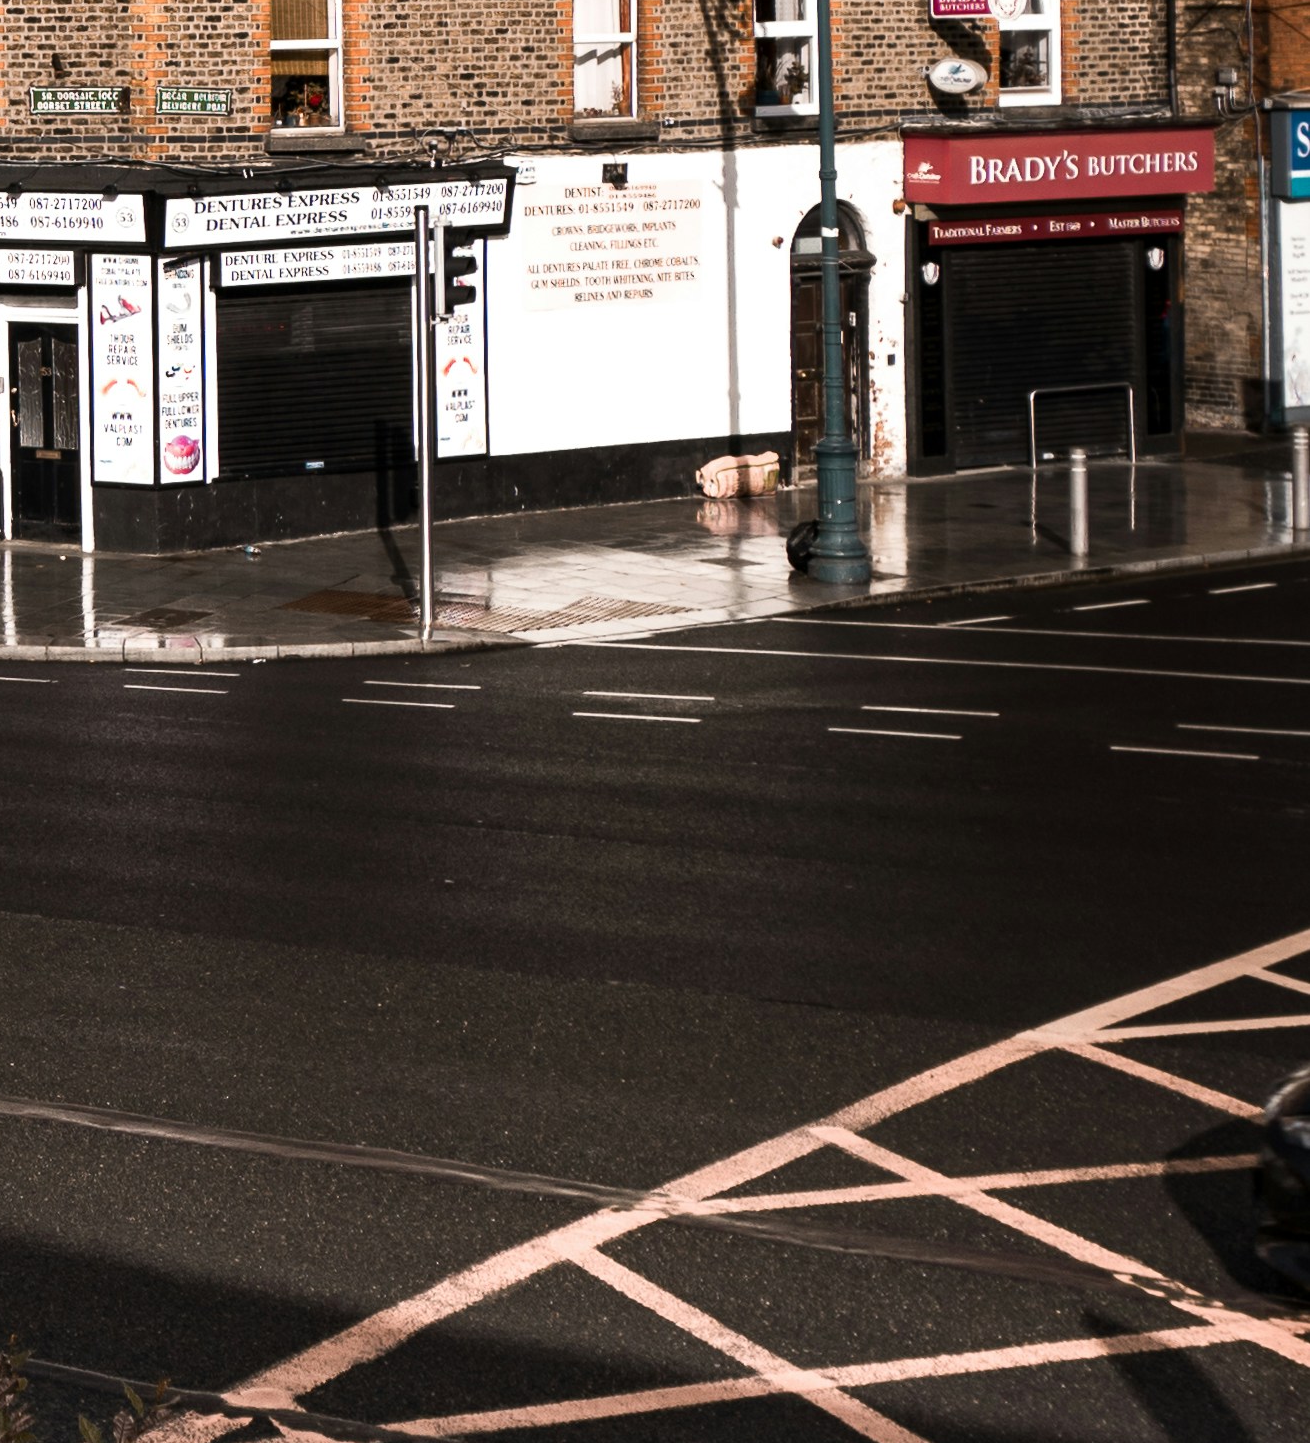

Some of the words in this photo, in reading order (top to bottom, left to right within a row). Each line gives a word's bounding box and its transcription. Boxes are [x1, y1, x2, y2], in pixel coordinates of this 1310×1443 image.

[939, 3, 985, 11] BUTCHERS
[37, 101, 71, 111] DORSET
[206, 102, 227, 112] ROAD
[970, 149, 1080, 185] BRADY'S
[1088, 151, 1199, 177] BUTCHERS
[29, 196, 103, 211] 087-2717200
[194, 196, 282, 214] DENTURES
[287, 191, 360, 209] EXPRESS
[372, 186, 431, 203] 01-8551549
[440, 182, 505, 198] 087-2717200
[121, 211, 134, 224] 53
[205, 215, 271, 232] DENTAL
[275, 209, 348, 227] EXPRESS
[439, 200, 503, 216] 087-6169940
[174, 217, 187, 229] 53
[225, 253, 279, 267] DENTURE
[283, 249, 335, 263] EXPRESS
[230, 268, 275, 282] DENTAL
[279, 265, 330, 279] EXPRESS
[166, 334, 194, 345] SHIELDS
[106, 355, 138, 366] SERVICE
[178, 391, 200, 403] UPPER
[161, 406, 176, 416] FULL
[164, 417, 198, 430] DENTURES
